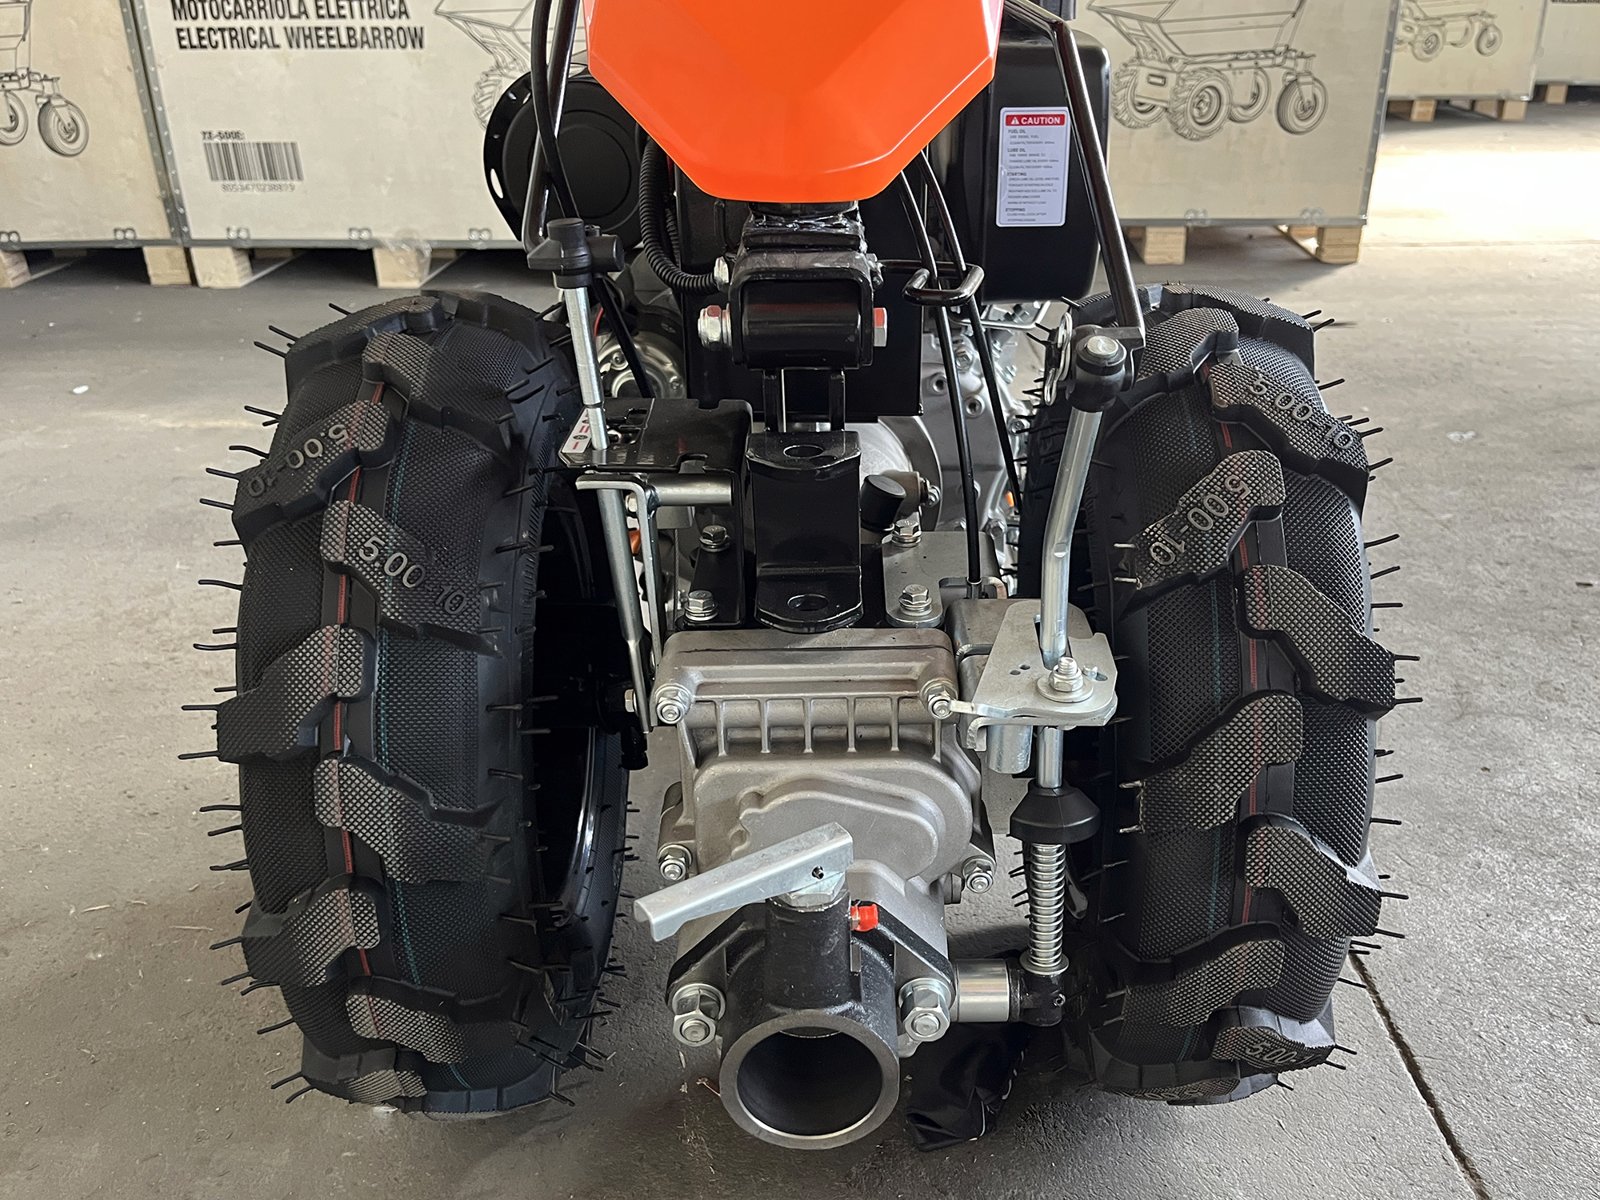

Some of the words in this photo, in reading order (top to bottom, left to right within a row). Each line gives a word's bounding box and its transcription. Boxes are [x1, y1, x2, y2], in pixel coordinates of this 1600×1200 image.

[171, 0, 309, 20] MOTOCARRIOLA
[315, 0, 410, 19] ELETTRICA
[176, 27, 281, 49] ELECTRICAL
[284, 26, 424, 49] WHEELBARROW
[1021, 117, 1060, 125] CAUTION
[1149, 475, 1252, 566] 5.00-10
[358, 535, 467, 615] 5.00-10
